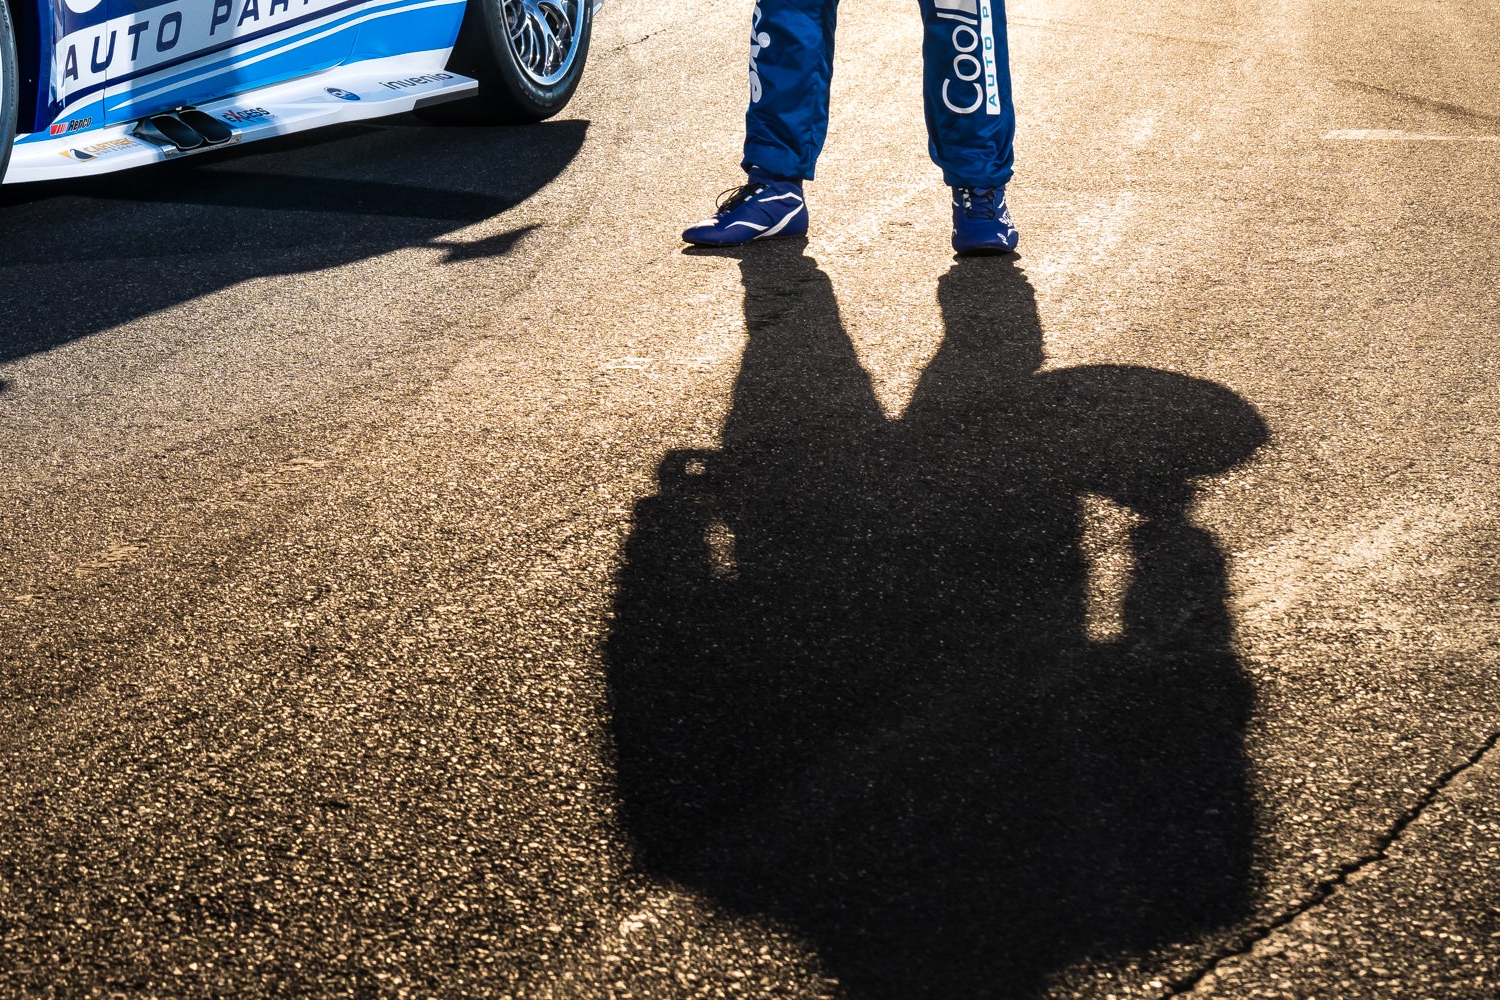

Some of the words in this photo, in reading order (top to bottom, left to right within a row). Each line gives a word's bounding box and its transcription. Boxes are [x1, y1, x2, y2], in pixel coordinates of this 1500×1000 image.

[61, 11, 183, 87] AUTO
[983, 36, 998, 107] AUTO
[379, 72, 454, 91] invenio
[68, 117, 92, 132] Repco
